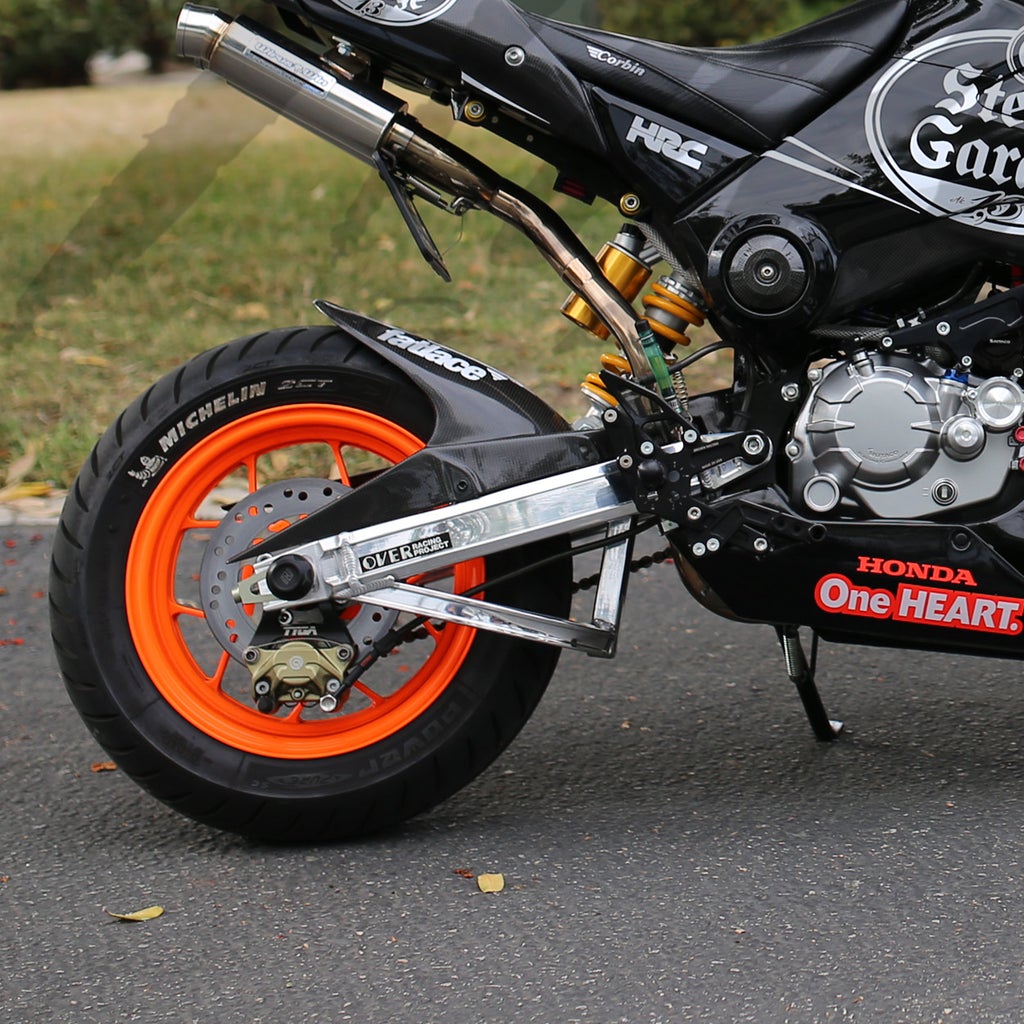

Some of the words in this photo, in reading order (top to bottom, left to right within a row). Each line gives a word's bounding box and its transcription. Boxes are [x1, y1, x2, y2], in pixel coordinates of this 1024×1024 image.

[597, 50, 646, 76] Corbin
[625, 115, 709, 171] HRC
[377, 329, 487, 381] fatlace
[158, 381, 267, 453] MICHELIN
[362, 544, 414, 570] OVER
[412, 536, 442, 550] RACING
[413, 540, 449, 557] PROJECT
[856, 556, 978, 586] HONDA
[819, 577, 891, 614] One
